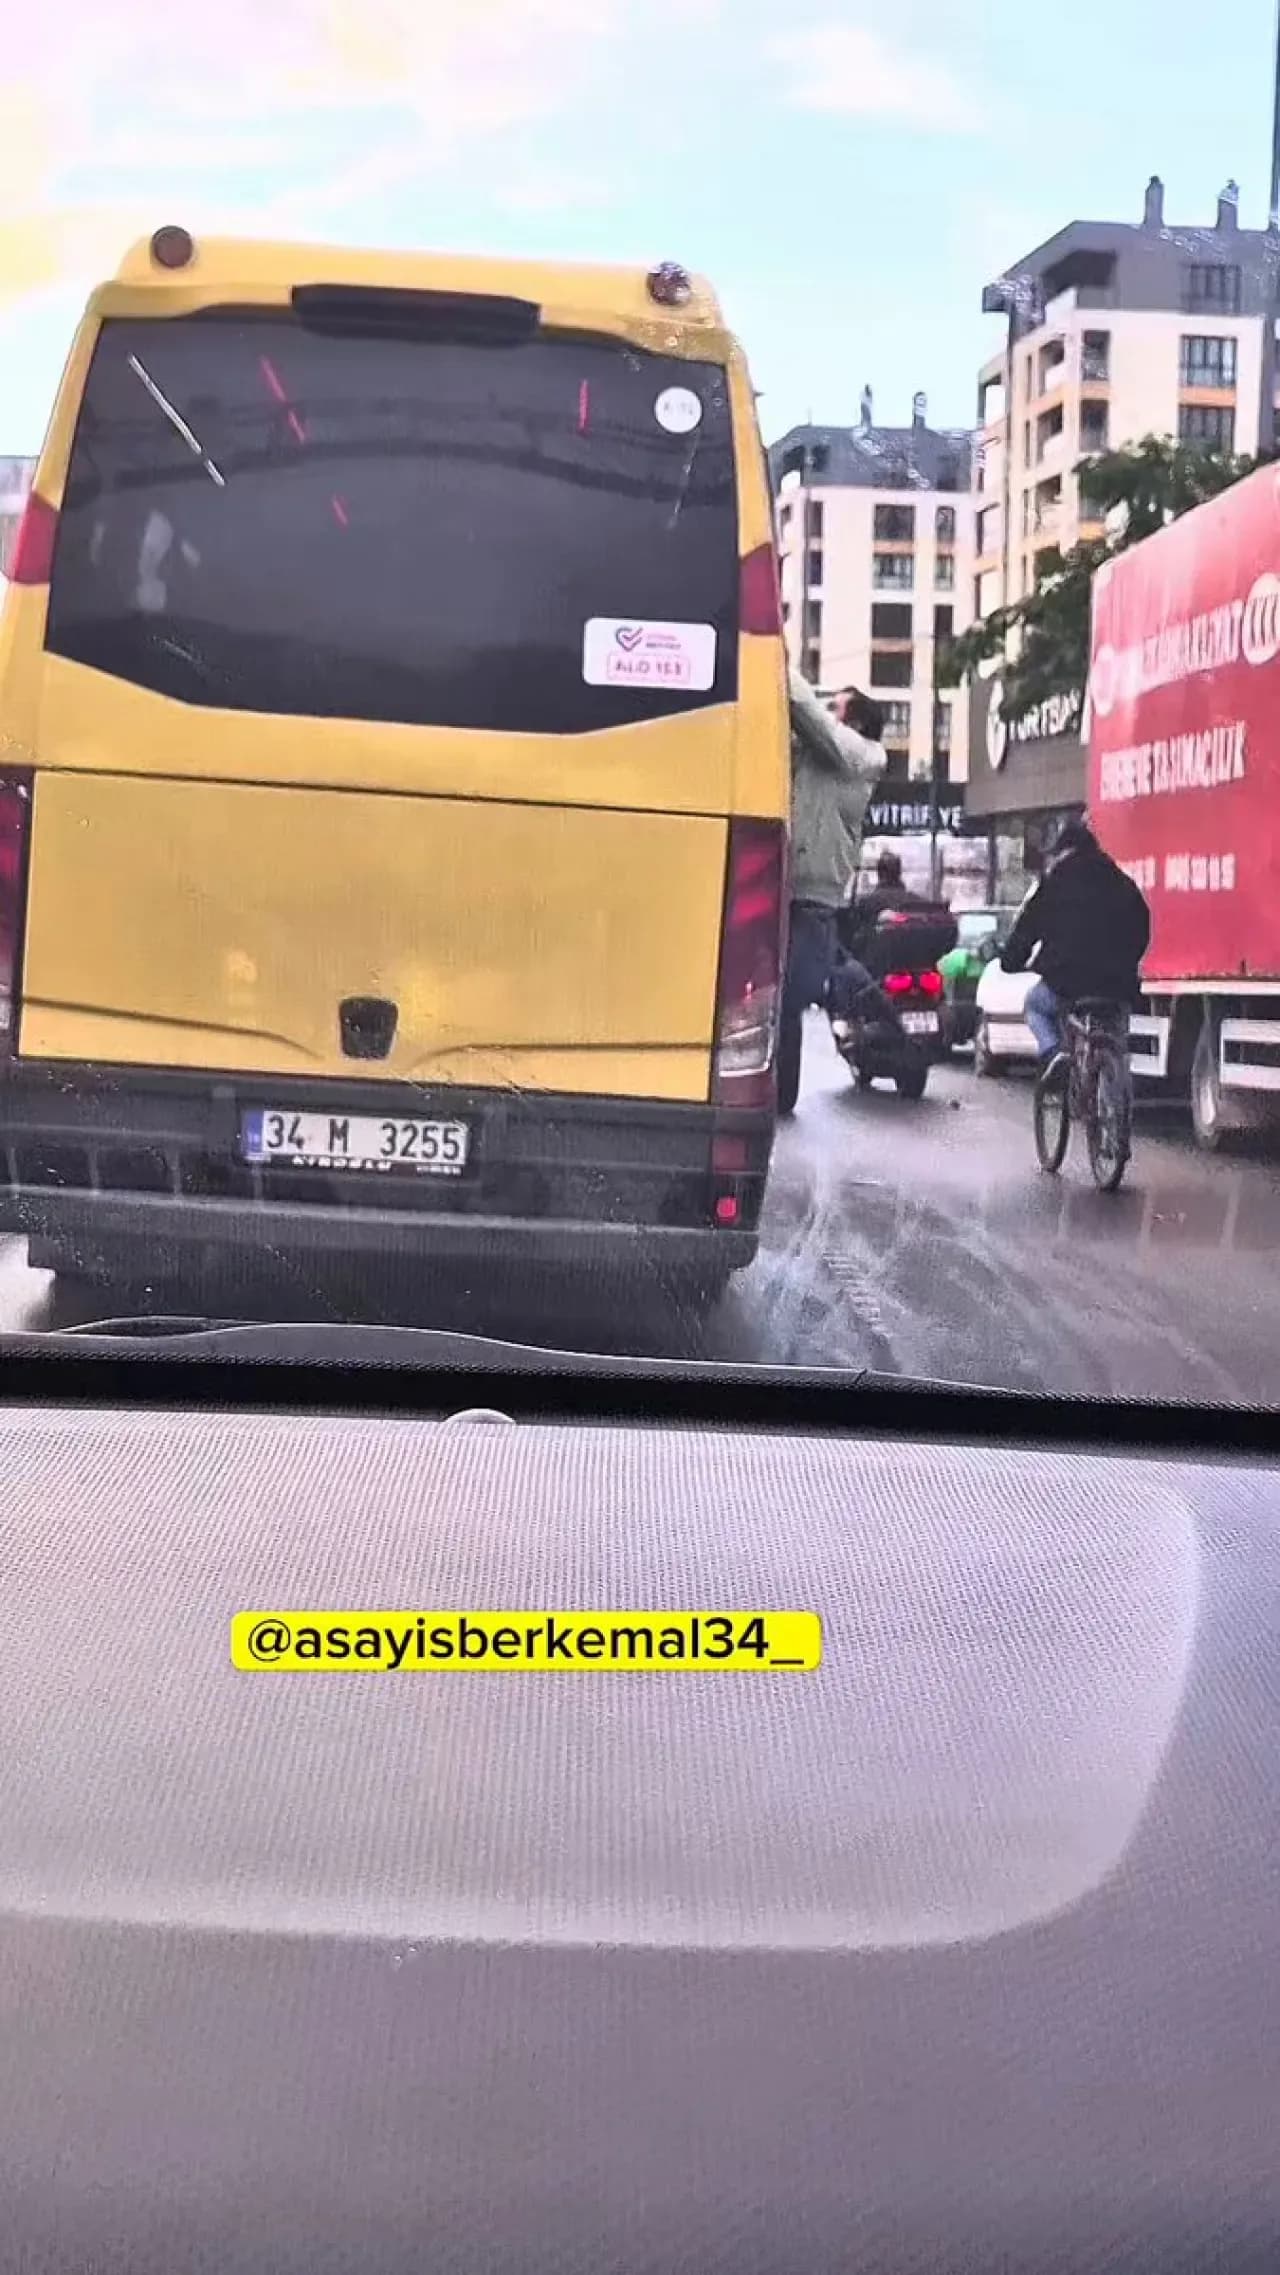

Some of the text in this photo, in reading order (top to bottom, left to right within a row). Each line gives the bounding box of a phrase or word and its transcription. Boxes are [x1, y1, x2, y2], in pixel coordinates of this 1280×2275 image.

[870, 800, 962, 829] VİTRİFYE
[266, 1114, 461, 1161] 34 M 3255
